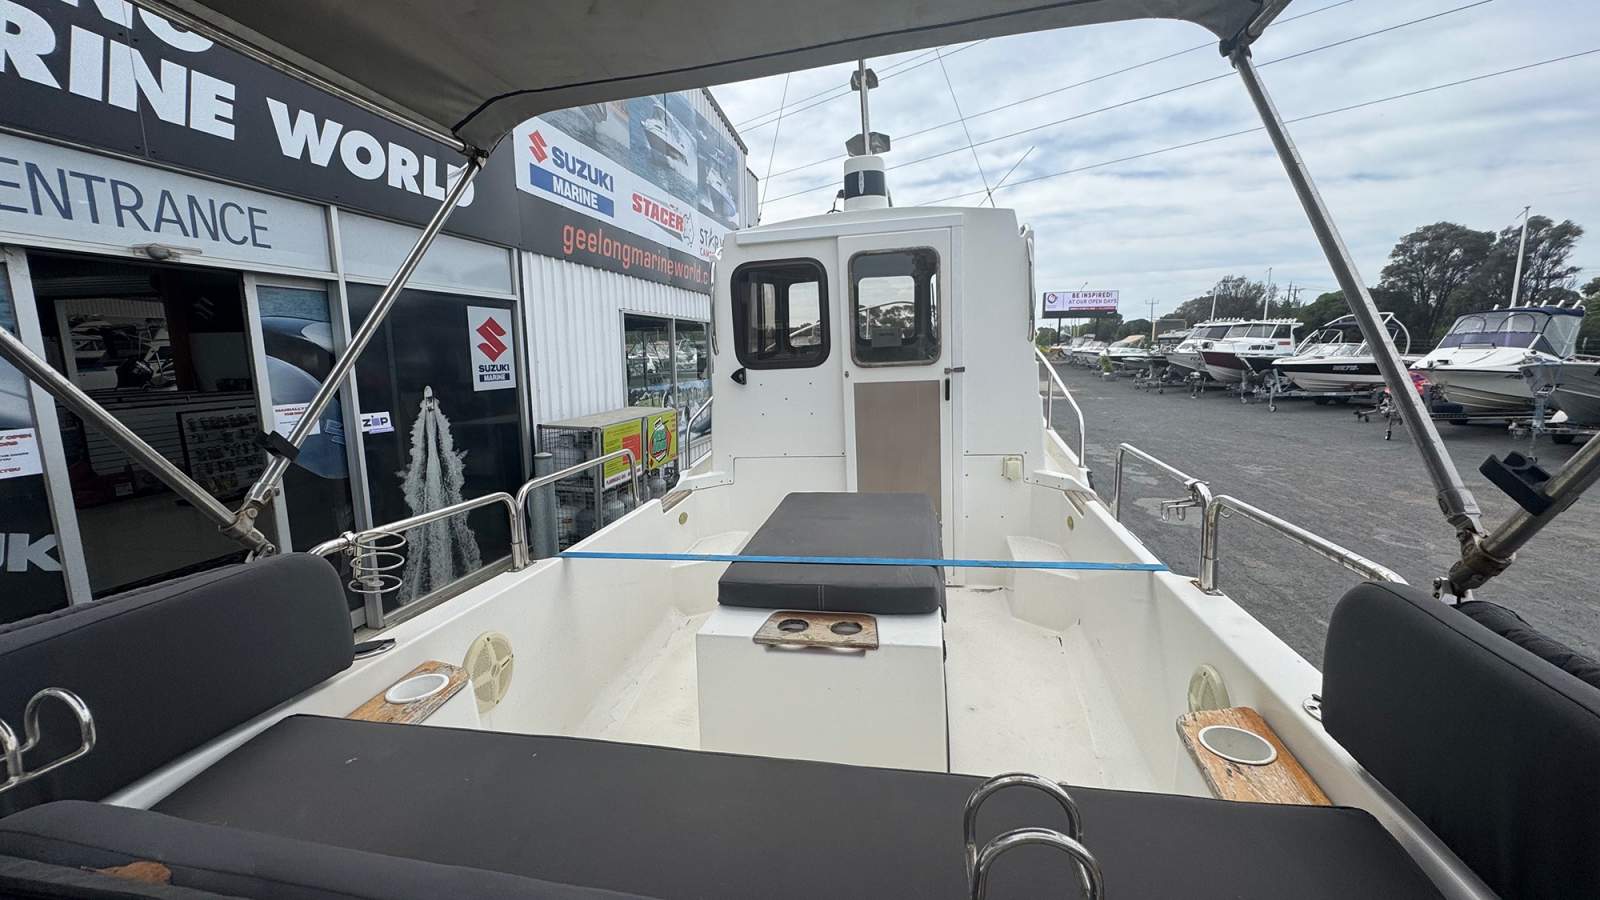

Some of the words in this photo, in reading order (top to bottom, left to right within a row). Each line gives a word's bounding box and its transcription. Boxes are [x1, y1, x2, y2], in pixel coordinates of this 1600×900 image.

[551, 146, 614, 192] SUZUKI
[0, 157, 272, 249] ENTRANCE
[552, 175, 600, 209] MARINE
[631, 192, 684, 232] STACER
[478, 364, 510, 372] SUZUKI
